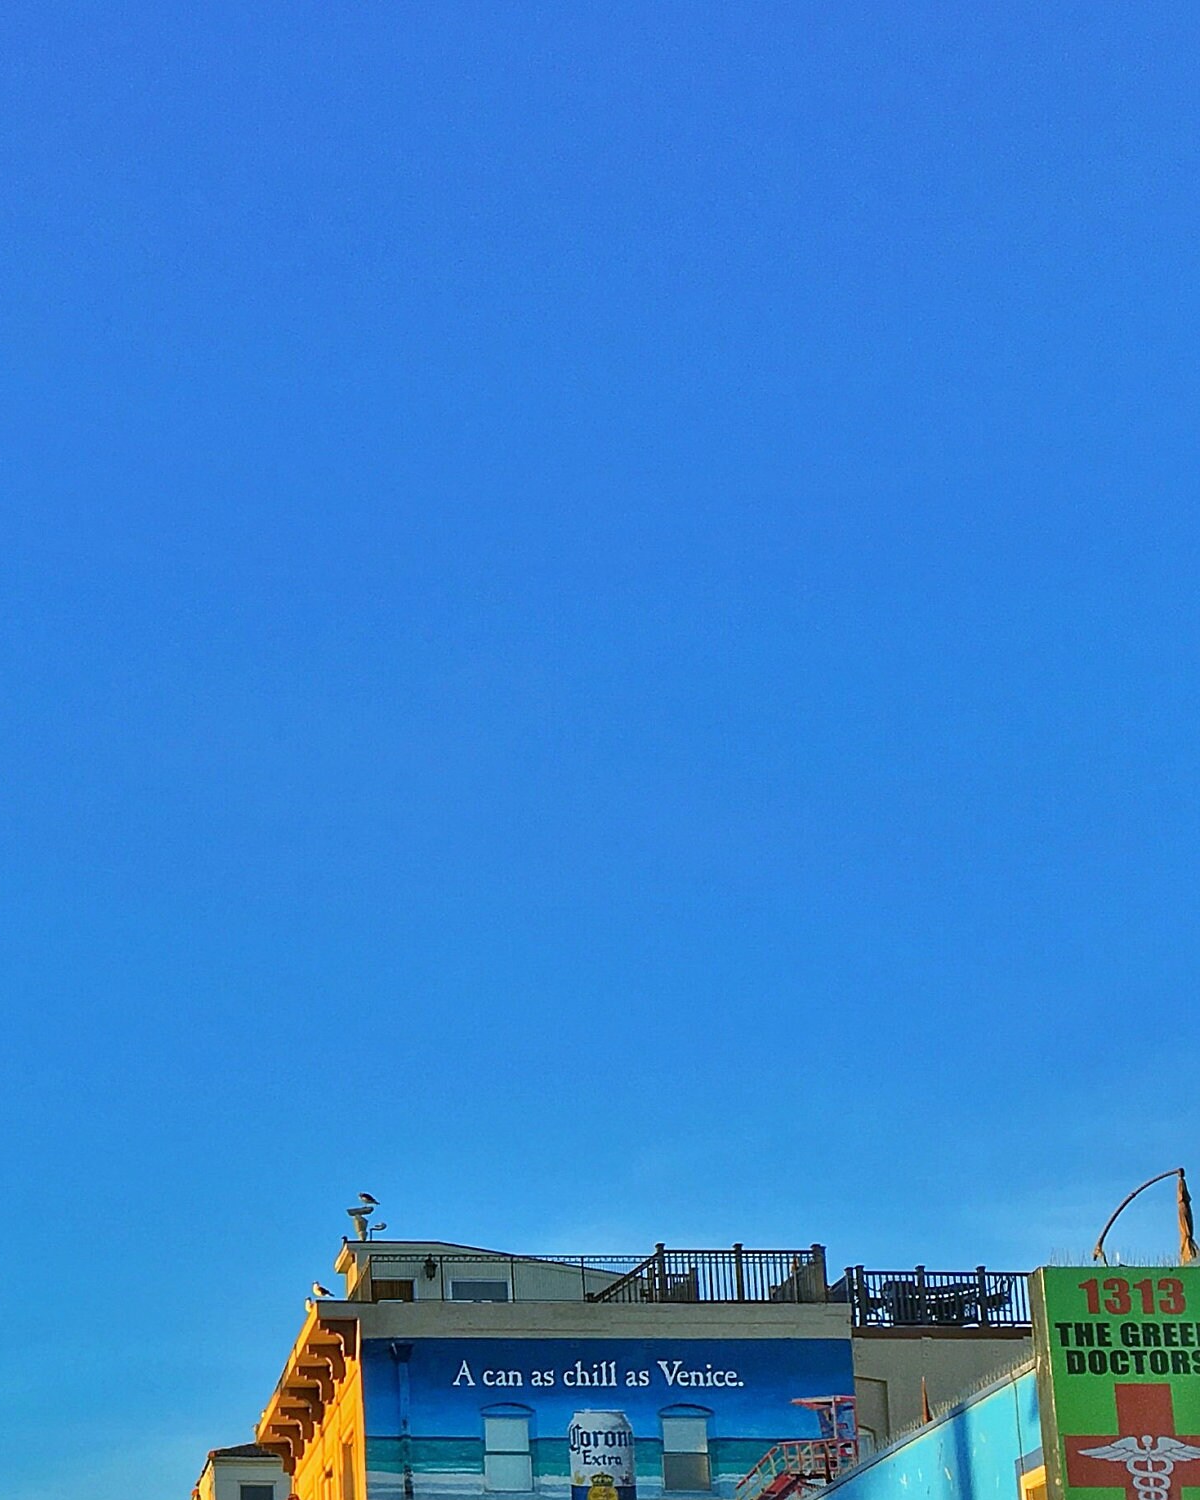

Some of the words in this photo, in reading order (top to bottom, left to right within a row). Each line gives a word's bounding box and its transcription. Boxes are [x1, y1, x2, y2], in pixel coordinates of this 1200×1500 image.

[1078, 1277, 1186, 1315] 1313
[1054, 1322, 1113, 1347] THE
[1119, 1322, 1200, 1347] GREE
[452, 1360, 475, 1387] A
[482, 1367, 524, 1388] can
[530, 1368, 554, 1387] as
[563, 1360, 618, 1387] chill
[625, 1368, 650, 1387] as
[657, 1360, 745, 1388] Venice.
[582, 1450, 623, 1466] Extra
